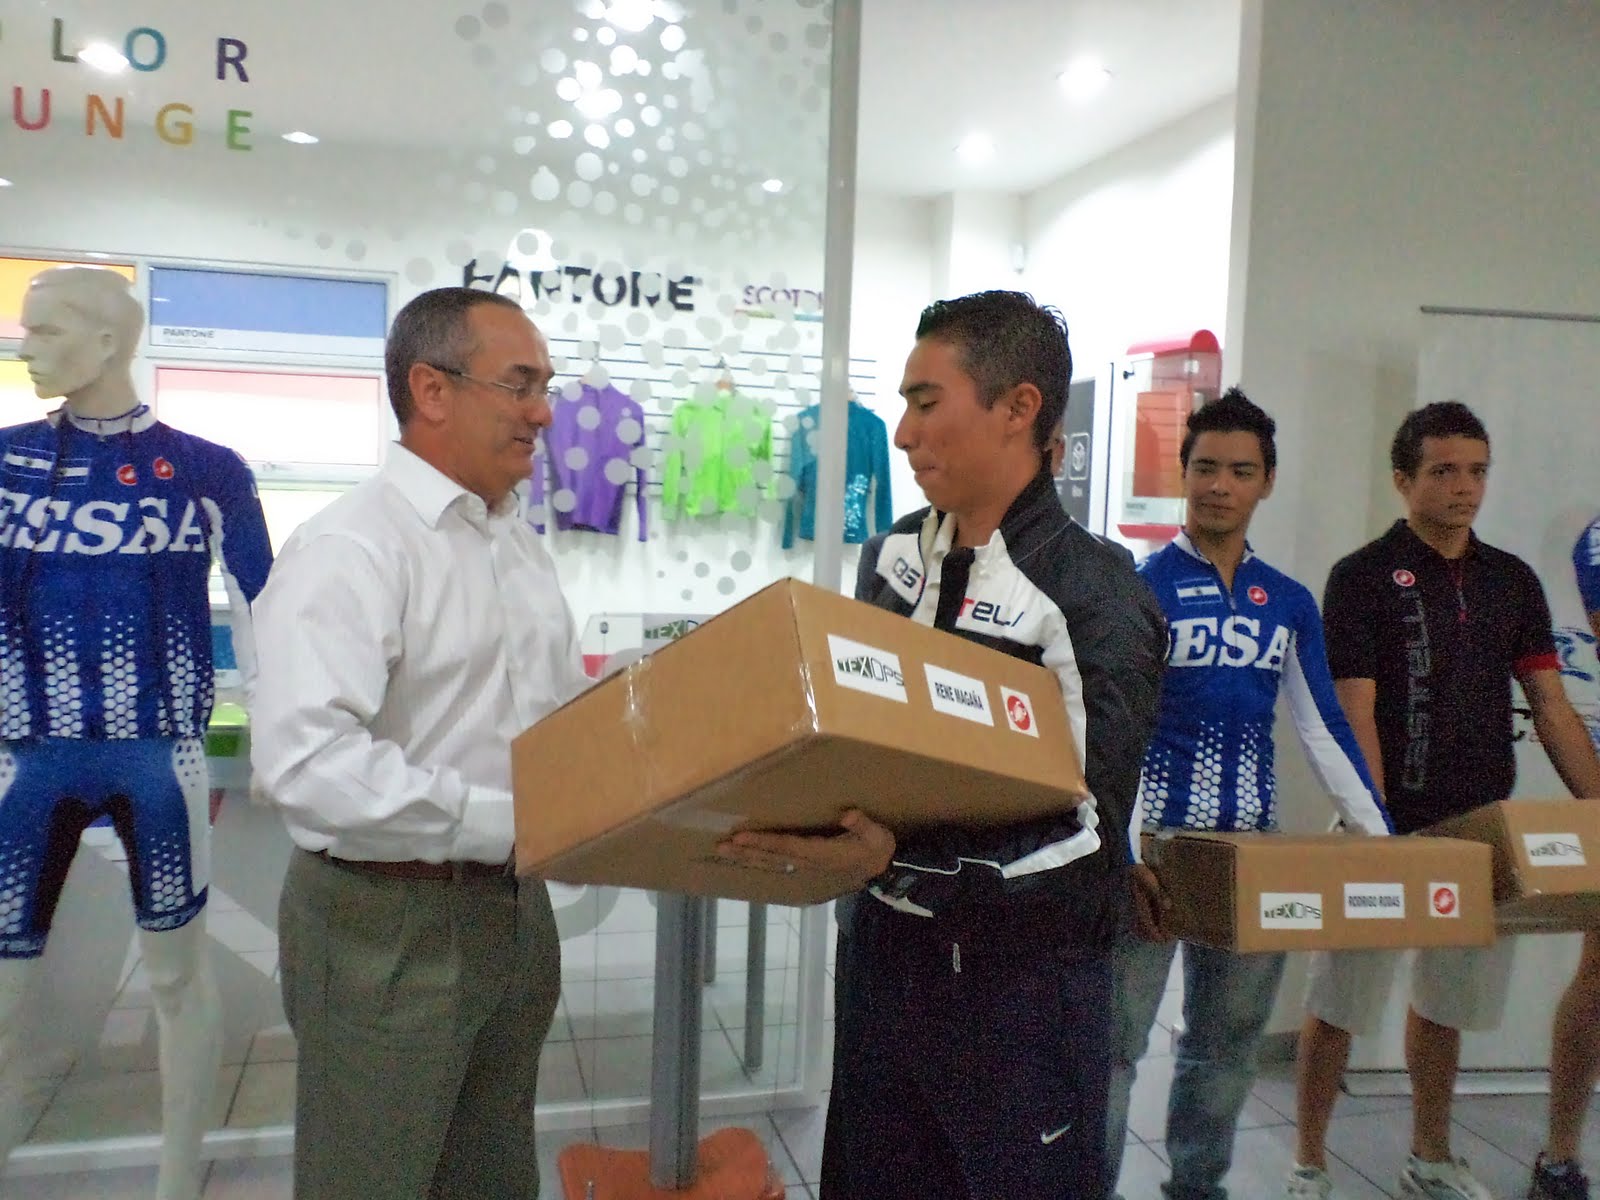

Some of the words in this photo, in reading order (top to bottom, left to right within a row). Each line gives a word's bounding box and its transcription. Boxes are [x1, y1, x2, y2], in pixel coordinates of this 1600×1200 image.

[0, 17, 249, 83] LOR
[12, 85, 254, 151] UNGE
[1168, 615, 1290, 674] ESA
